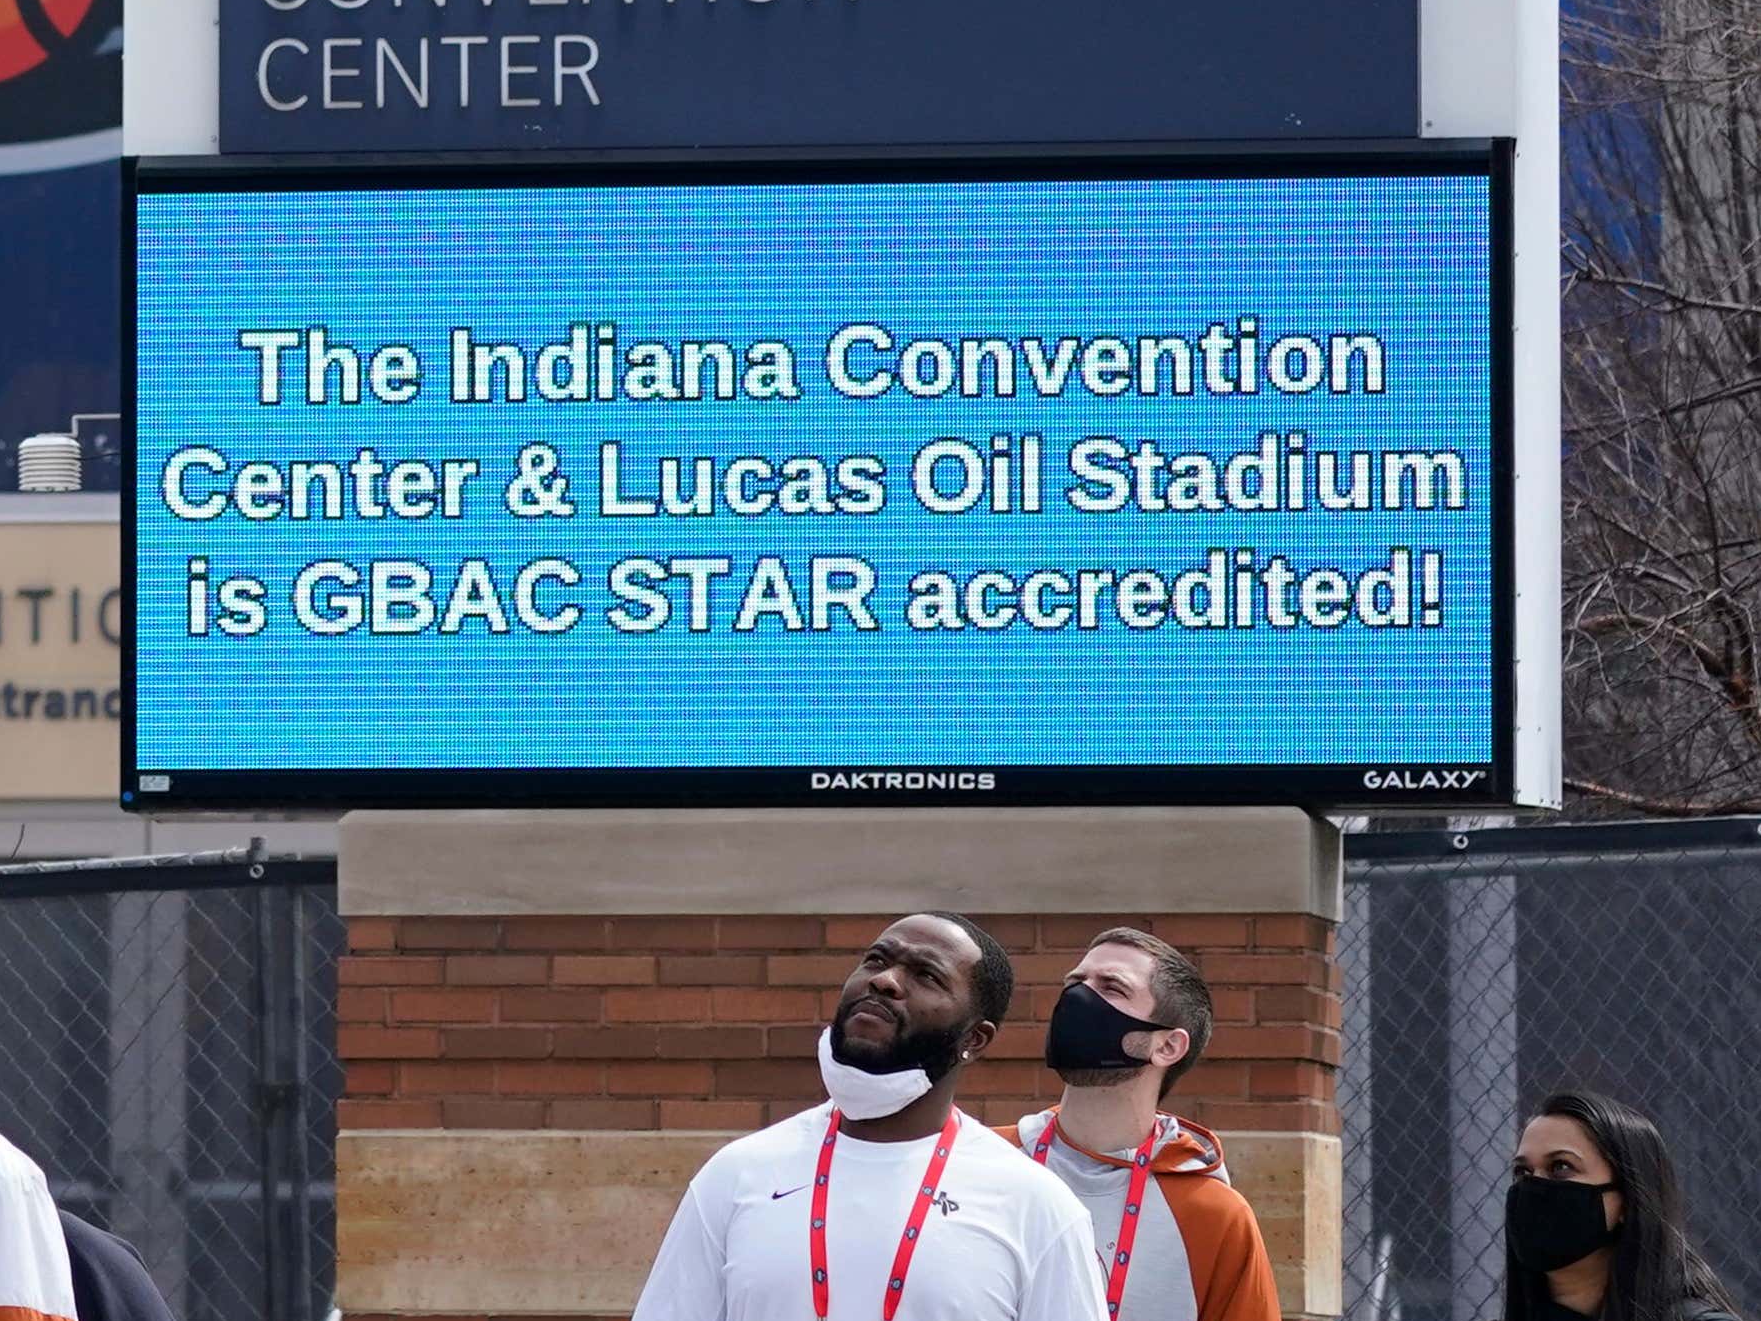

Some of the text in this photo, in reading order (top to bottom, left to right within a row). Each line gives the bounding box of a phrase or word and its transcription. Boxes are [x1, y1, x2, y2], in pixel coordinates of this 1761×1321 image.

[257, 34, 602, 113] CENTER
[241, 320, 1386, 405] The Indiana Convention
[163, 436, 1465, 521] Center & Lucas Oil Stadium
[189, 552, 1443, 636] is GBAC STAR accredited!
[811, 773, 996, 791] DAKTRONICS
[1363, 771, 1479, 790] GALAXY
